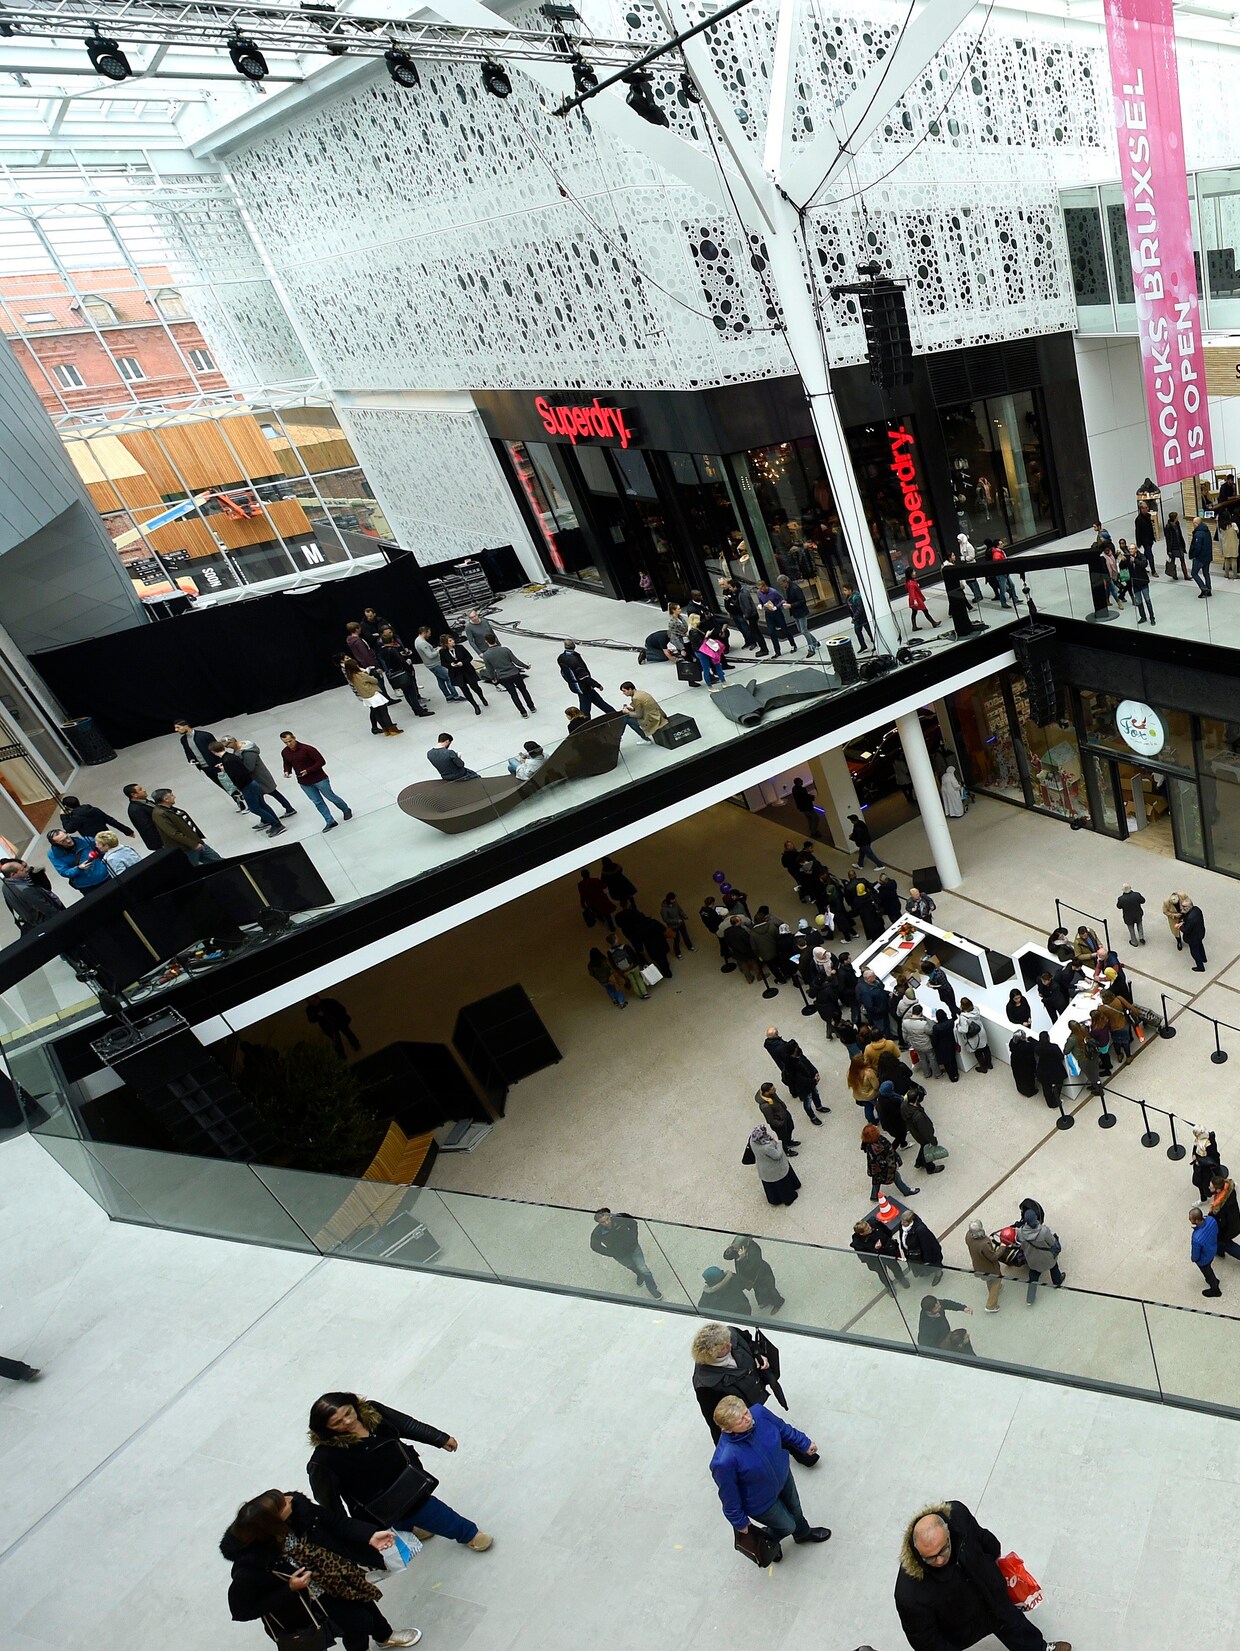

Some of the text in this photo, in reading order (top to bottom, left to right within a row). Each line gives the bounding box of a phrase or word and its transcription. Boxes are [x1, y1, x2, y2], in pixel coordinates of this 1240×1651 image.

[1122, 68, 1182, 468] DOCKS BRUXSEL
[1174, 302, 1205, 460] IS OPEN
[202, 567, 222, 588] SOON
